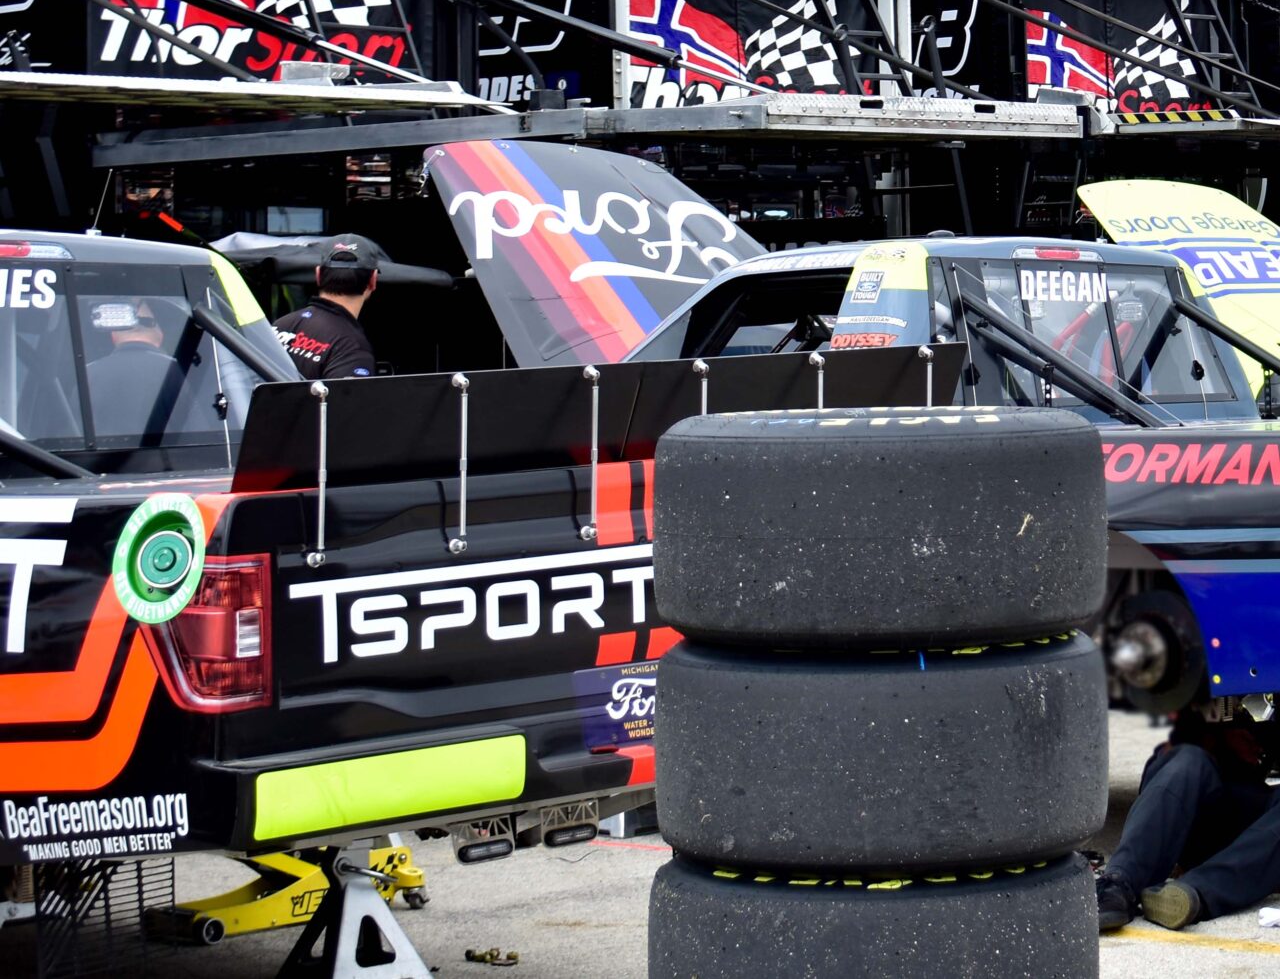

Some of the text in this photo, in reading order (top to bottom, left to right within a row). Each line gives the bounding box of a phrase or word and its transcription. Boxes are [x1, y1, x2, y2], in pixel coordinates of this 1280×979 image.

[1108, 215, 1193, 234] Doors
[450, 190, 742, 285] Ford
[860, 272, 882, 282] BUILT
[1021, 268, 1107, 303] DEEGAN
[854, 292, 876, 300] TOUGH
[831, 333, 899, 350] ODYSSEY
[289, 543, 654, 664] TSPORT
[623, 719, 648, 730] WATER
[3, 791, 189, 840] BeaFreemason.org
[71, 839, 101, 858] GOOD
[103, 837, 128, 855] MEN
